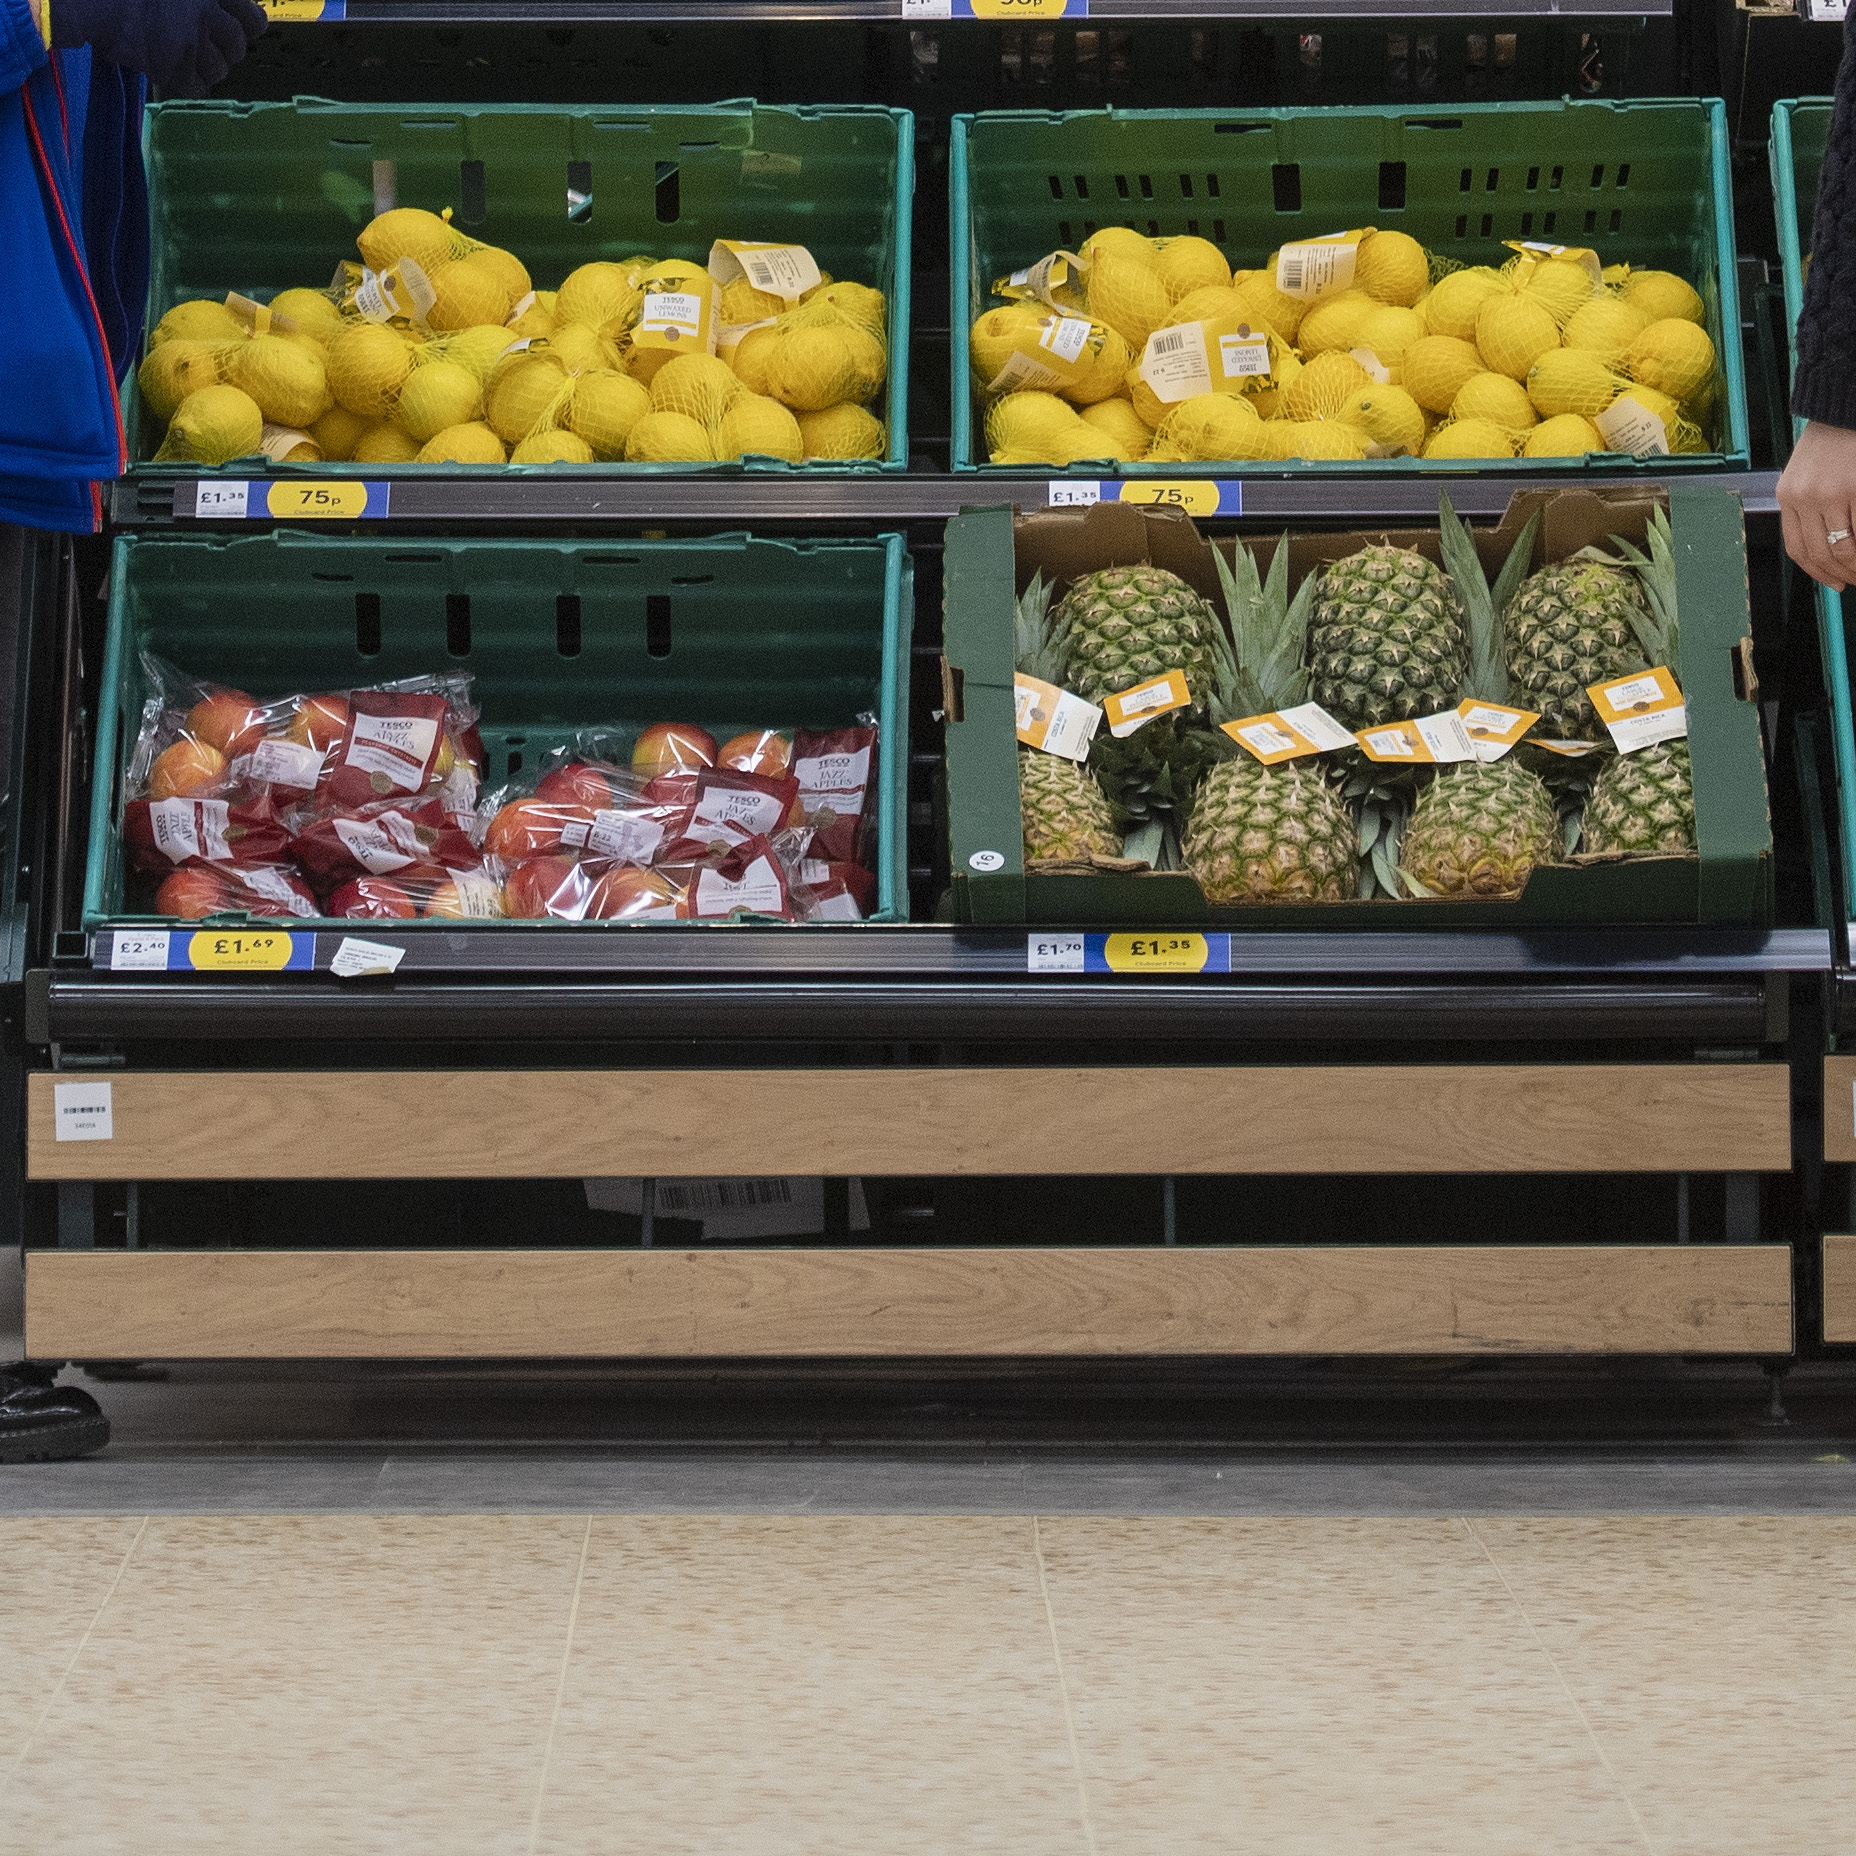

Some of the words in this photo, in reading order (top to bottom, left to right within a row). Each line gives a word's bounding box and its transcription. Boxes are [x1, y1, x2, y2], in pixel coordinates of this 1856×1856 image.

[654, 304, 692, 314] UNWAXED
[200, 492, 245, 504] £1.35
[299, 489, 342, 506] 75p
[1053, 491, 1097, 503] £1.35
[1151, 489, 1195, 505] 75p
[379, 720, 414, 730] TESCO
[818, 758, 851, 768] TESCO
[727, 794, 761, 806] TESCO
[976, 854, 995, 866] 16
[120, 942, 166, 954] £2.40
[214, 938, 274, 955] £1.69
[1037, 943, 1083, 956] £1.70
[1130, 940, 1191, 956] £1.35
